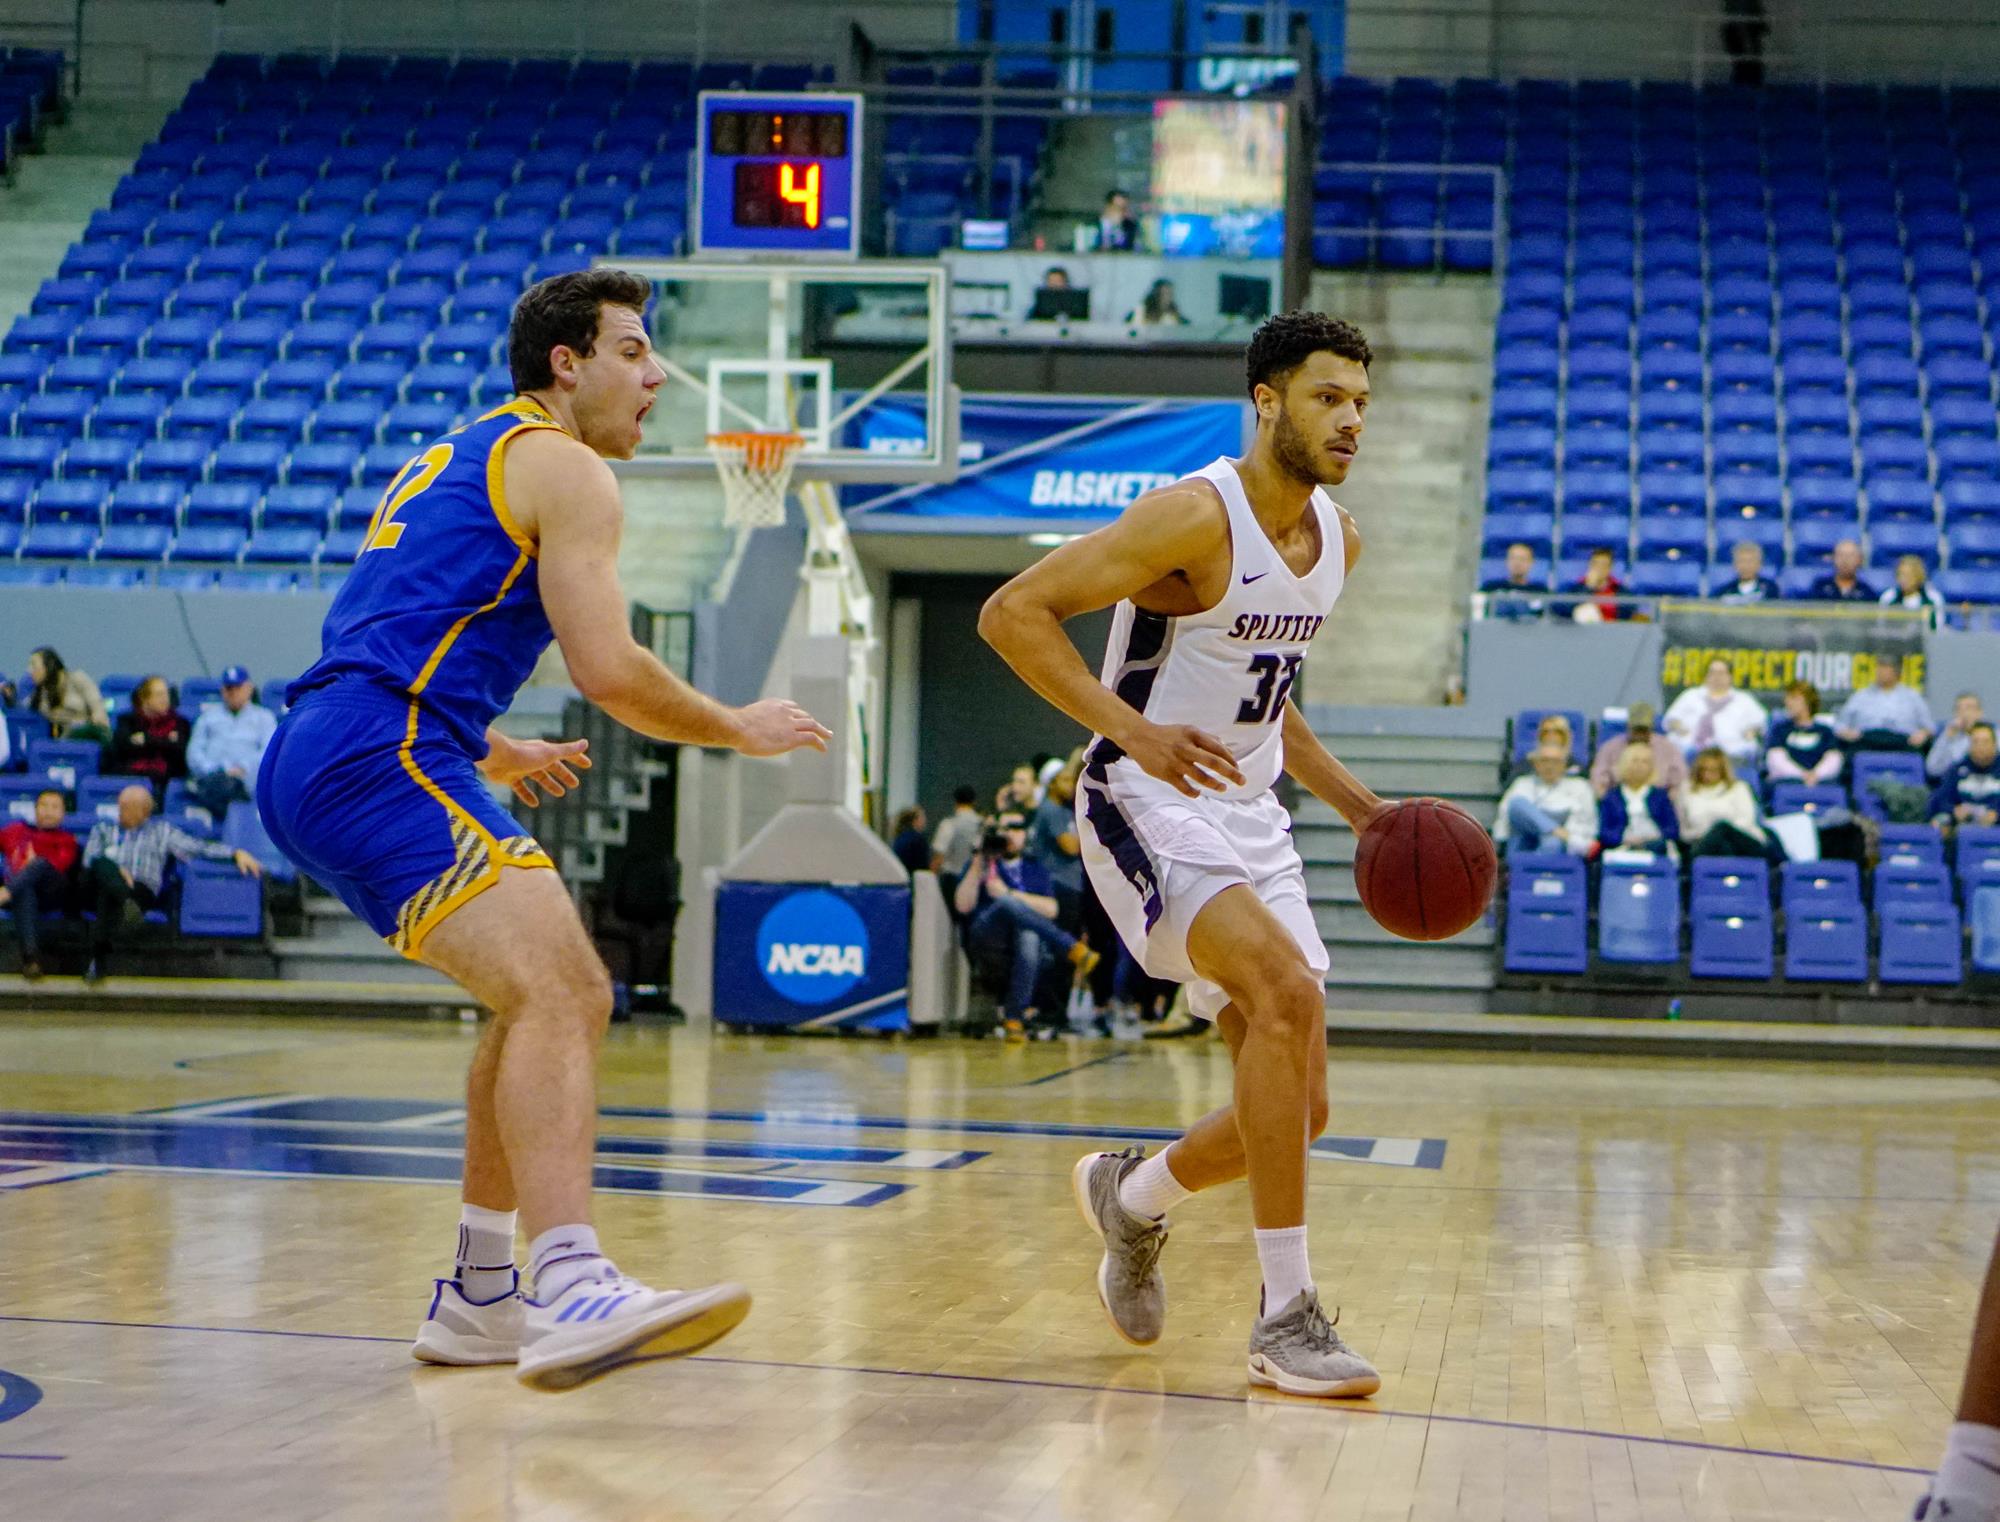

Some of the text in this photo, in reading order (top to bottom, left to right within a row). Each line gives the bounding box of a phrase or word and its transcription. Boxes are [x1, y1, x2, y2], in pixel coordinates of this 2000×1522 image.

[780, 162, 820, 229] 4
[1662, 647, 1926, 692] #REPECTOURGE
[767, 942, 865, 977] NCAA
